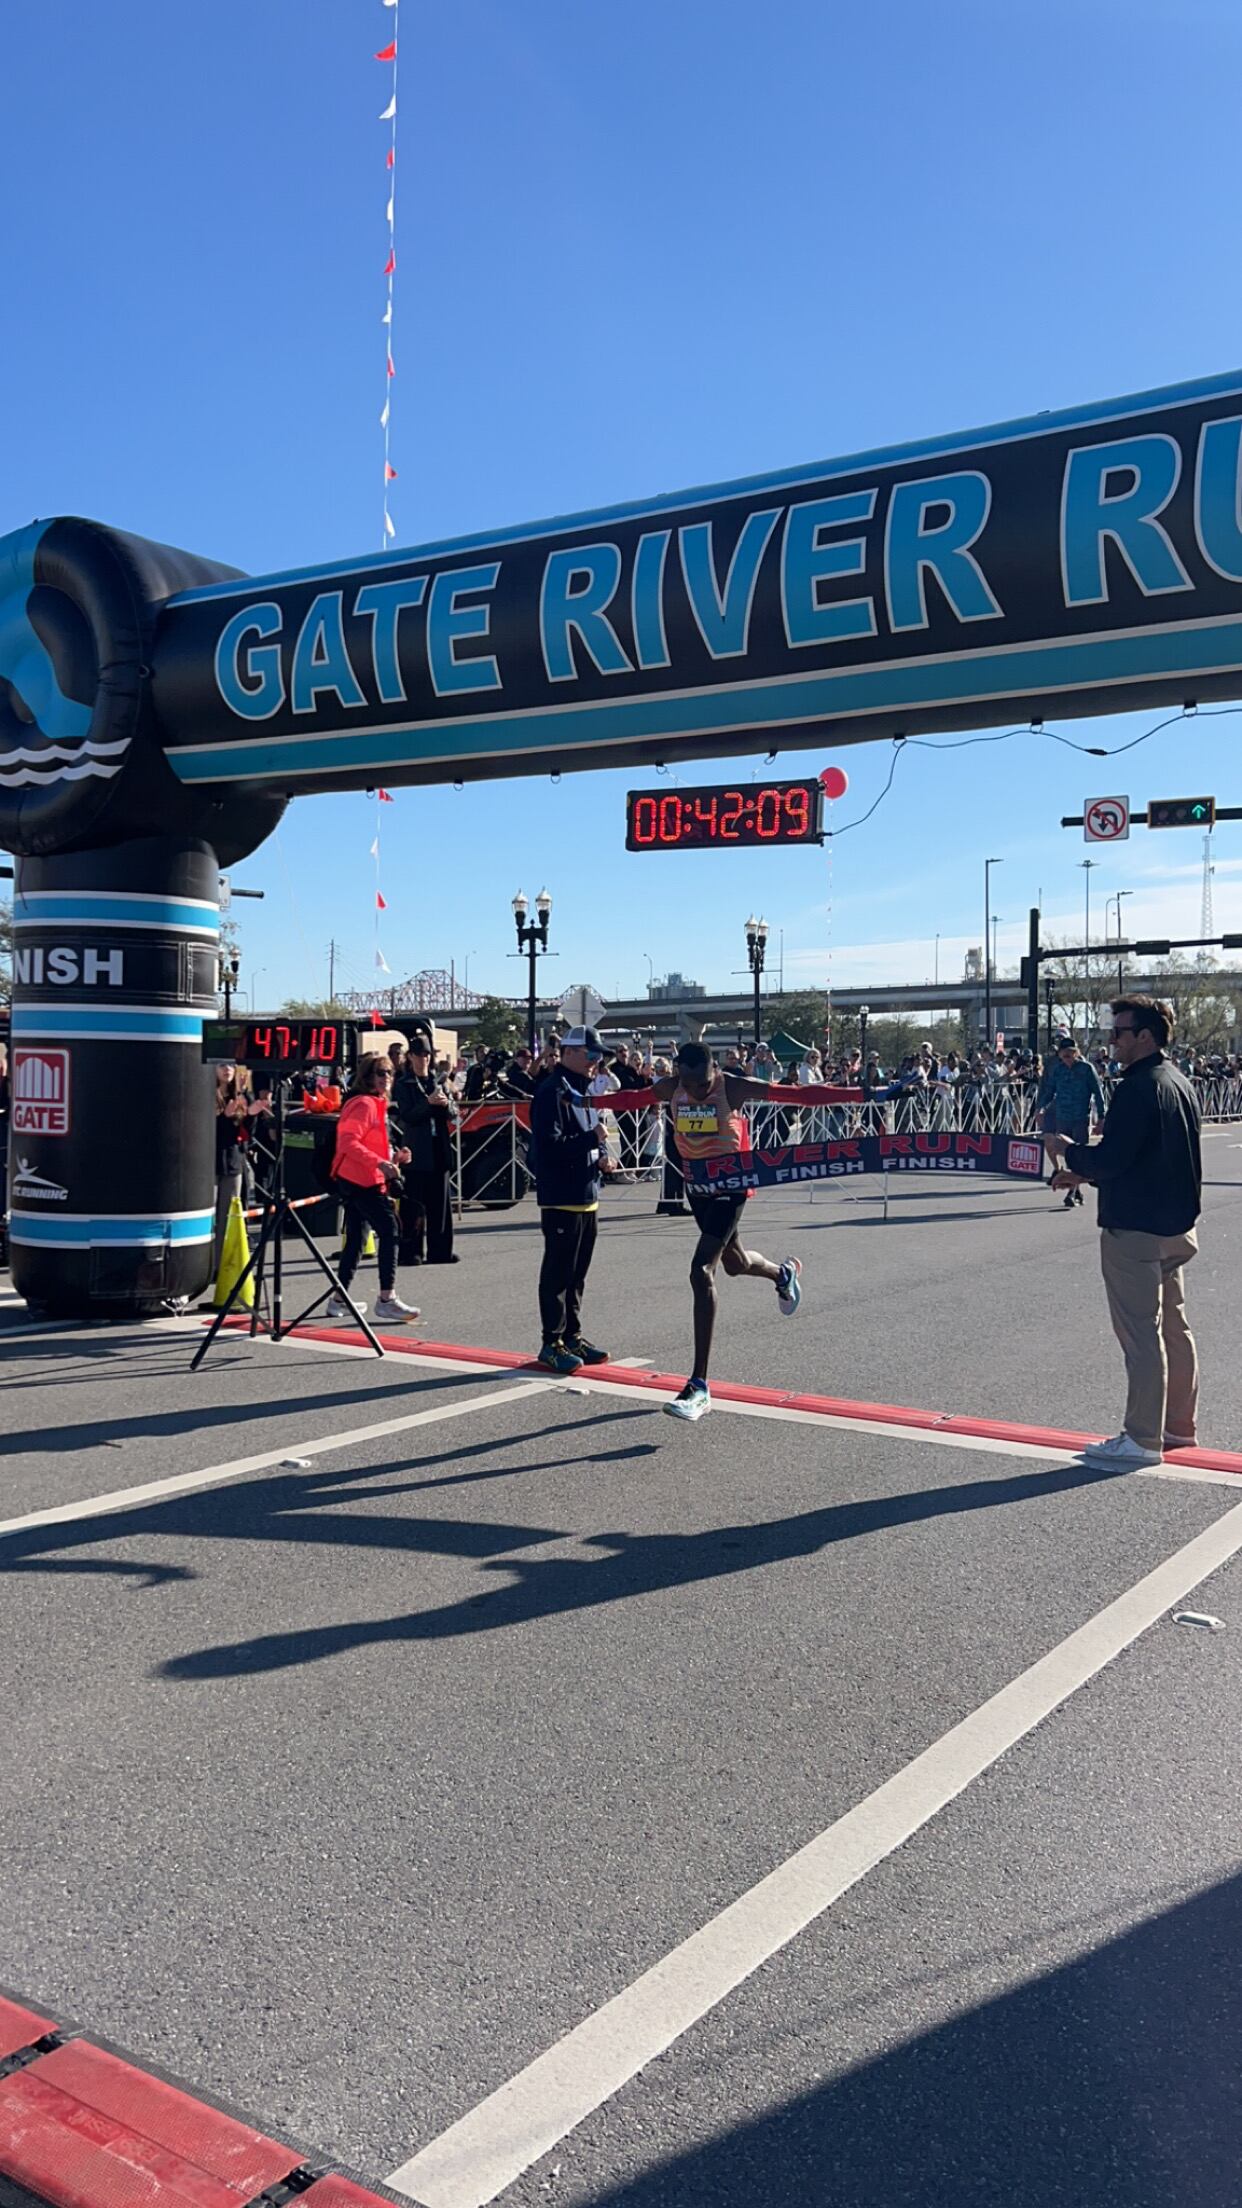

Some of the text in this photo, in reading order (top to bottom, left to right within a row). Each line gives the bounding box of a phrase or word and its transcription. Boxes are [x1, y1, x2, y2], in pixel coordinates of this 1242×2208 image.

[214, 561, 502, 721] GATE
[540, 469, 1005, 682] RIVER
[634, 787, 808, 843] 00:42:09
[14, 1104, 65, 1129] GATE
[689, 1120, 703, 1129] 77
[706, 1141, 861, 1178] RIVER
[880, 1134, 992, 1155] RUN
[1010, 1160, 1038, 1171] GATE
[776, 1161, 864, 1181] FINISH
[883, 1157, 976, 1169] FINISH
